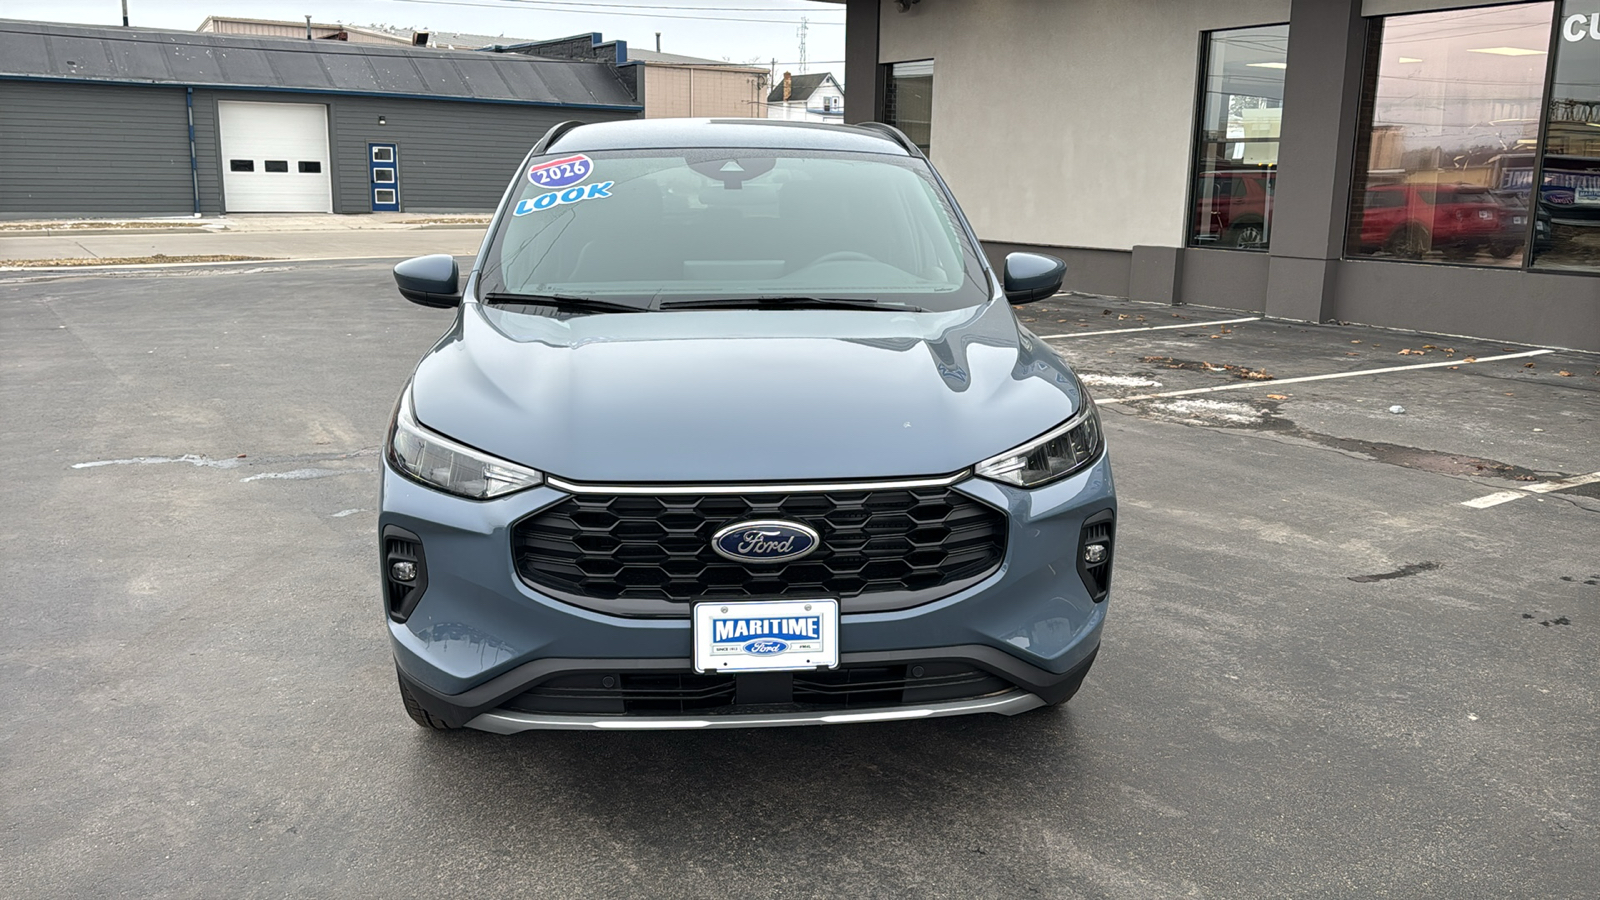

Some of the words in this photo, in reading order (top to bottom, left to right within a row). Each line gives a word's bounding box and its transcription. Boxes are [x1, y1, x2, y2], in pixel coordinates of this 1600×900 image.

[537, 160, 586, 184] 2026
[515, 181, 614, 216] LOOK
[737, 530, 795, 554] Ford
[715, 617, 818, 642] MARITIME
[751, 641, 780, 653] Ford
